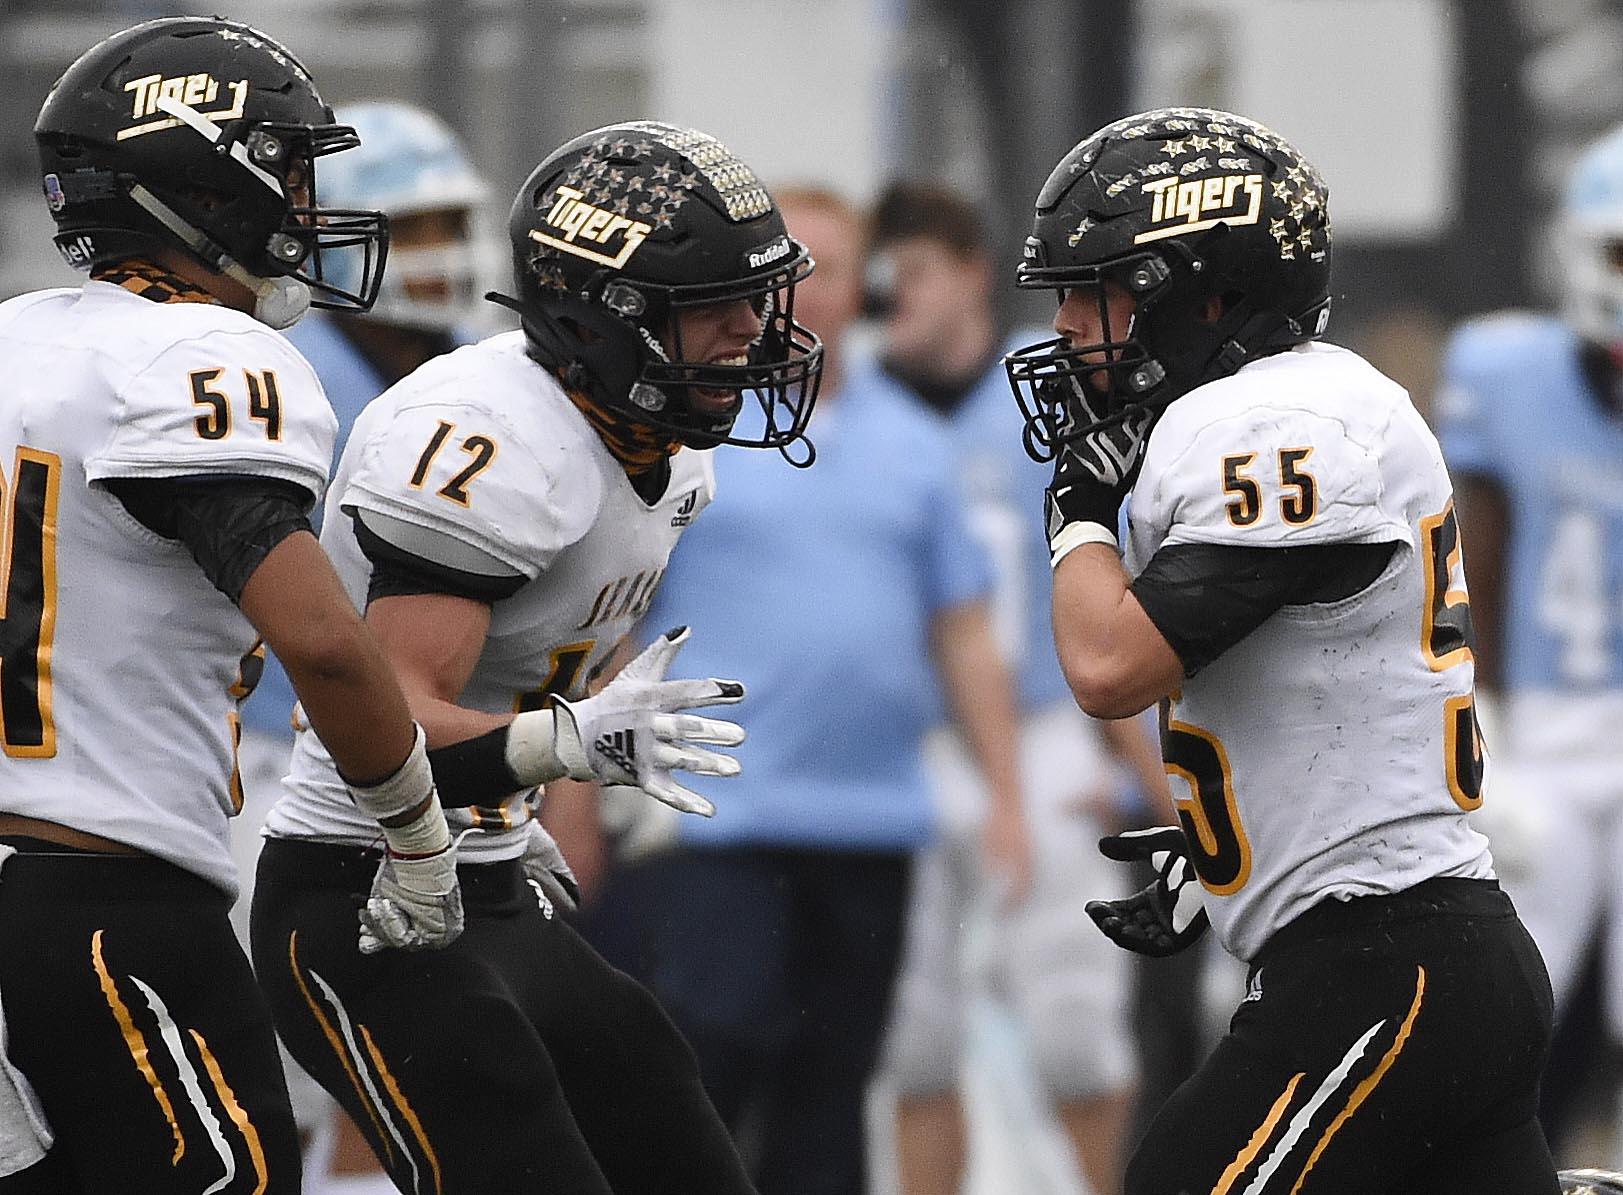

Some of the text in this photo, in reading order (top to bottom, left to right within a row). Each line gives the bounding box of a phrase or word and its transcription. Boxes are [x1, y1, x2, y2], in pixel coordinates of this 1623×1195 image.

[529, 185, 652, 270] Tigers
[1134, 174, 1263, 245] Tigers
[187, 366, 282, 443] 54
[408, 419, 499, 508] 12
[1220, 446, 1320, 528] 55
